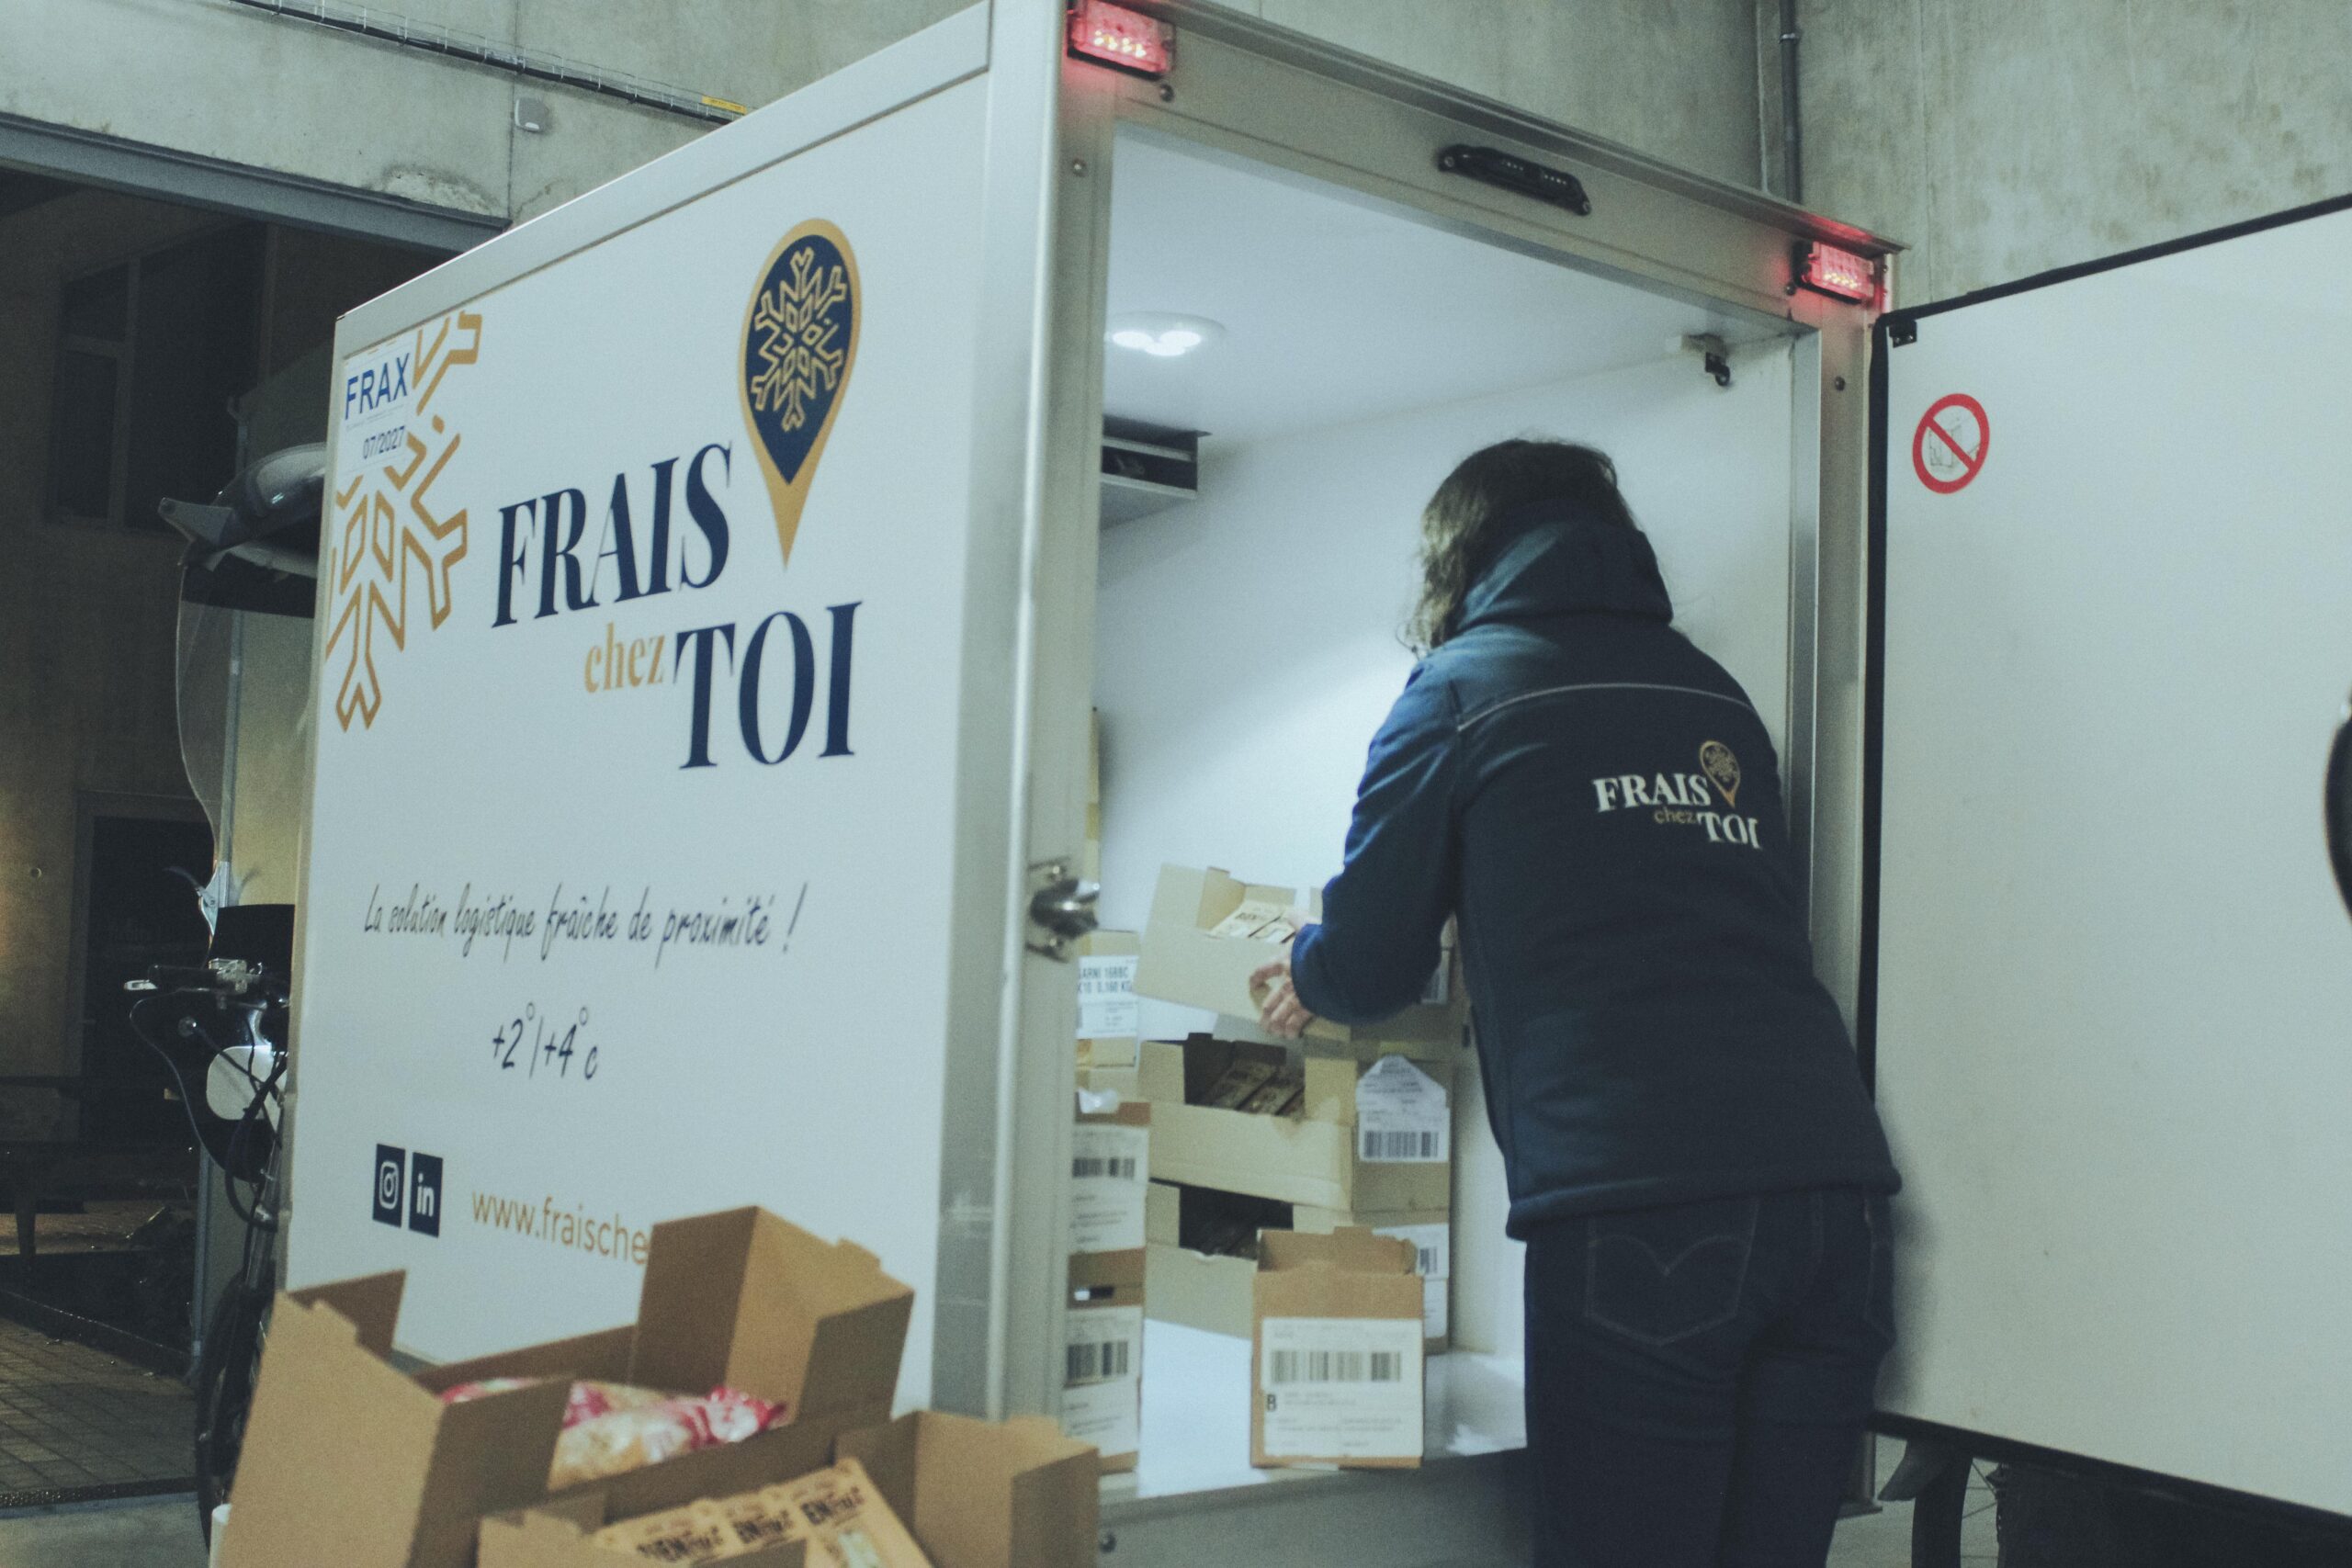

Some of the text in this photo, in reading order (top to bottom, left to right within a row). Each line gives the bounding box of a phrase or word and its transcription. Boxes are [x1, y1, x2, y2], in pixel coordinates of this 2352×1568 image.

[345, 353, 410, 420] FRAX
[363, 425, 405, 459] 07/2027
[492, 440, 733, 628] FRAIS
[583, 601, 863, 770] chez TOI
[1592, 773, 1712, 813] FRAIS
[1655, 806, 1763, 850] chez TOI
[364, 882, 808, 969] La solution logistique fraîche de proximité !
[416, 1173, 435, 1217] in
